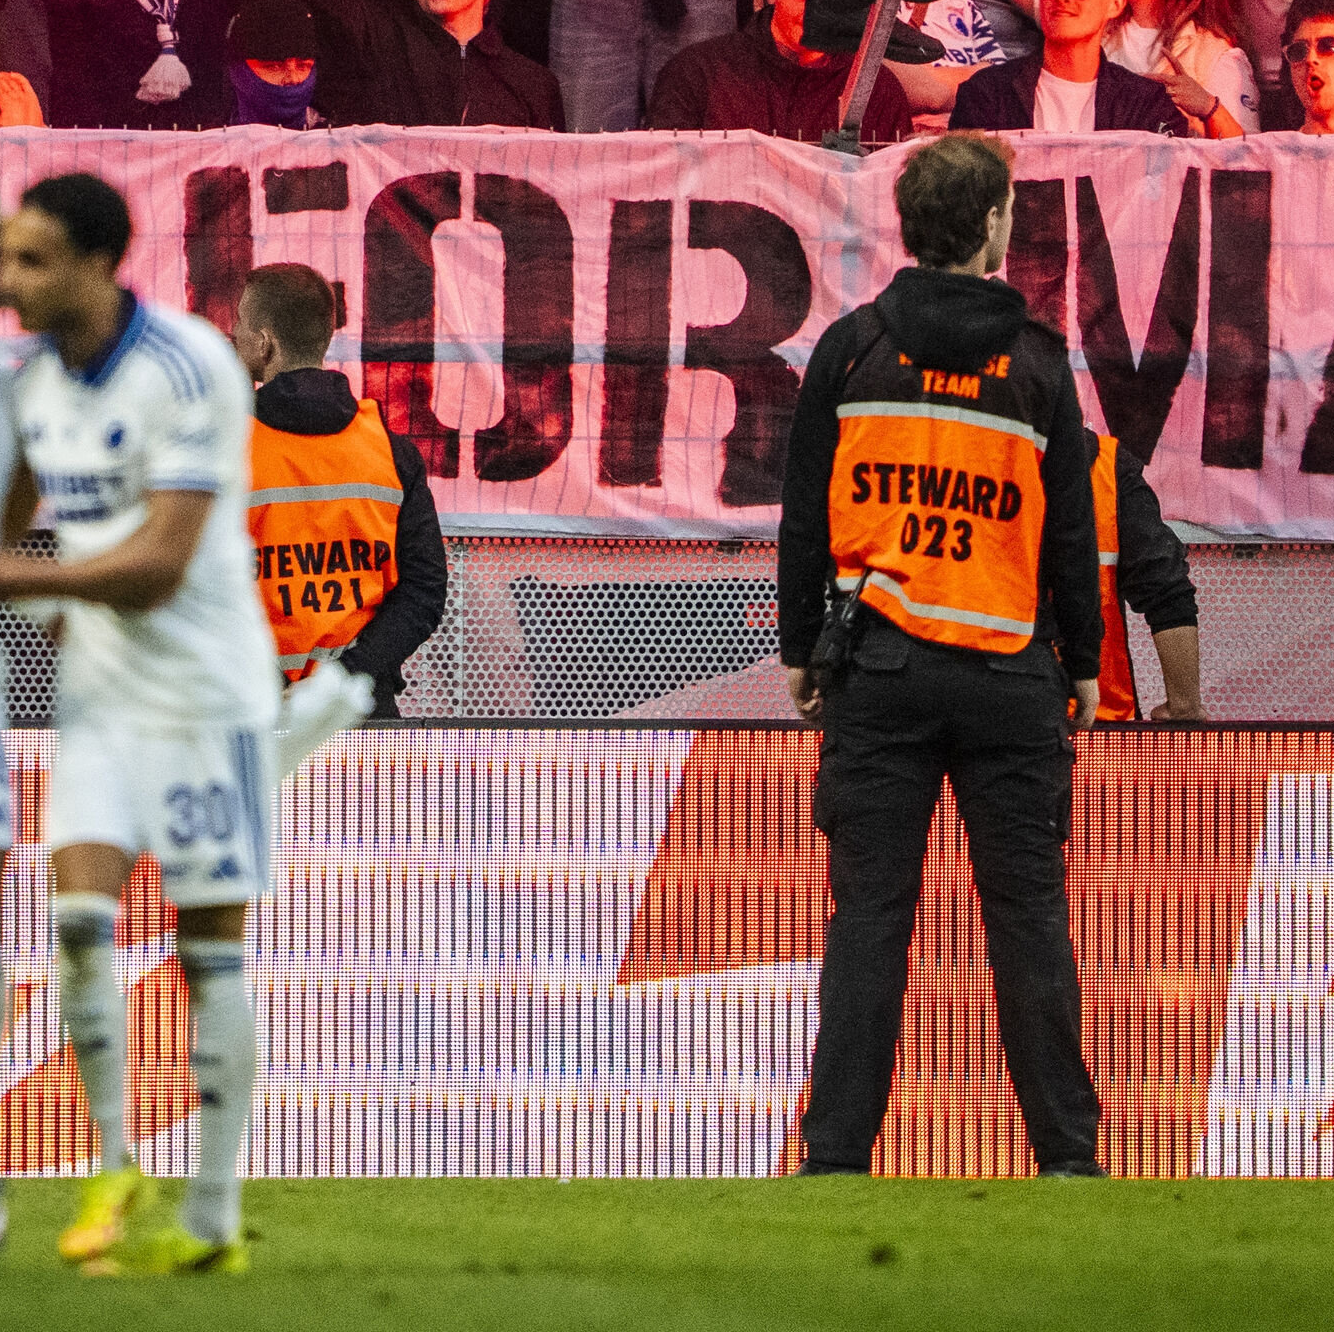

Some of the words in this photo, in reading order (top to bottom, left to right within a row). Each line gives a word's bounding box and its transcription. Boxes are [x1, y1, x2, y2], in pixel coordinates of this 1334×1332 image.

[184, 160, 813, 508] FOR
[922, 369, 981, 399] TEAM
[852, 462, 1022, 523] STEWARD
[901, 513, 973, 562] 023
[277, 577, 364, 617] 1421
[167, 782, 235, 847] 30
